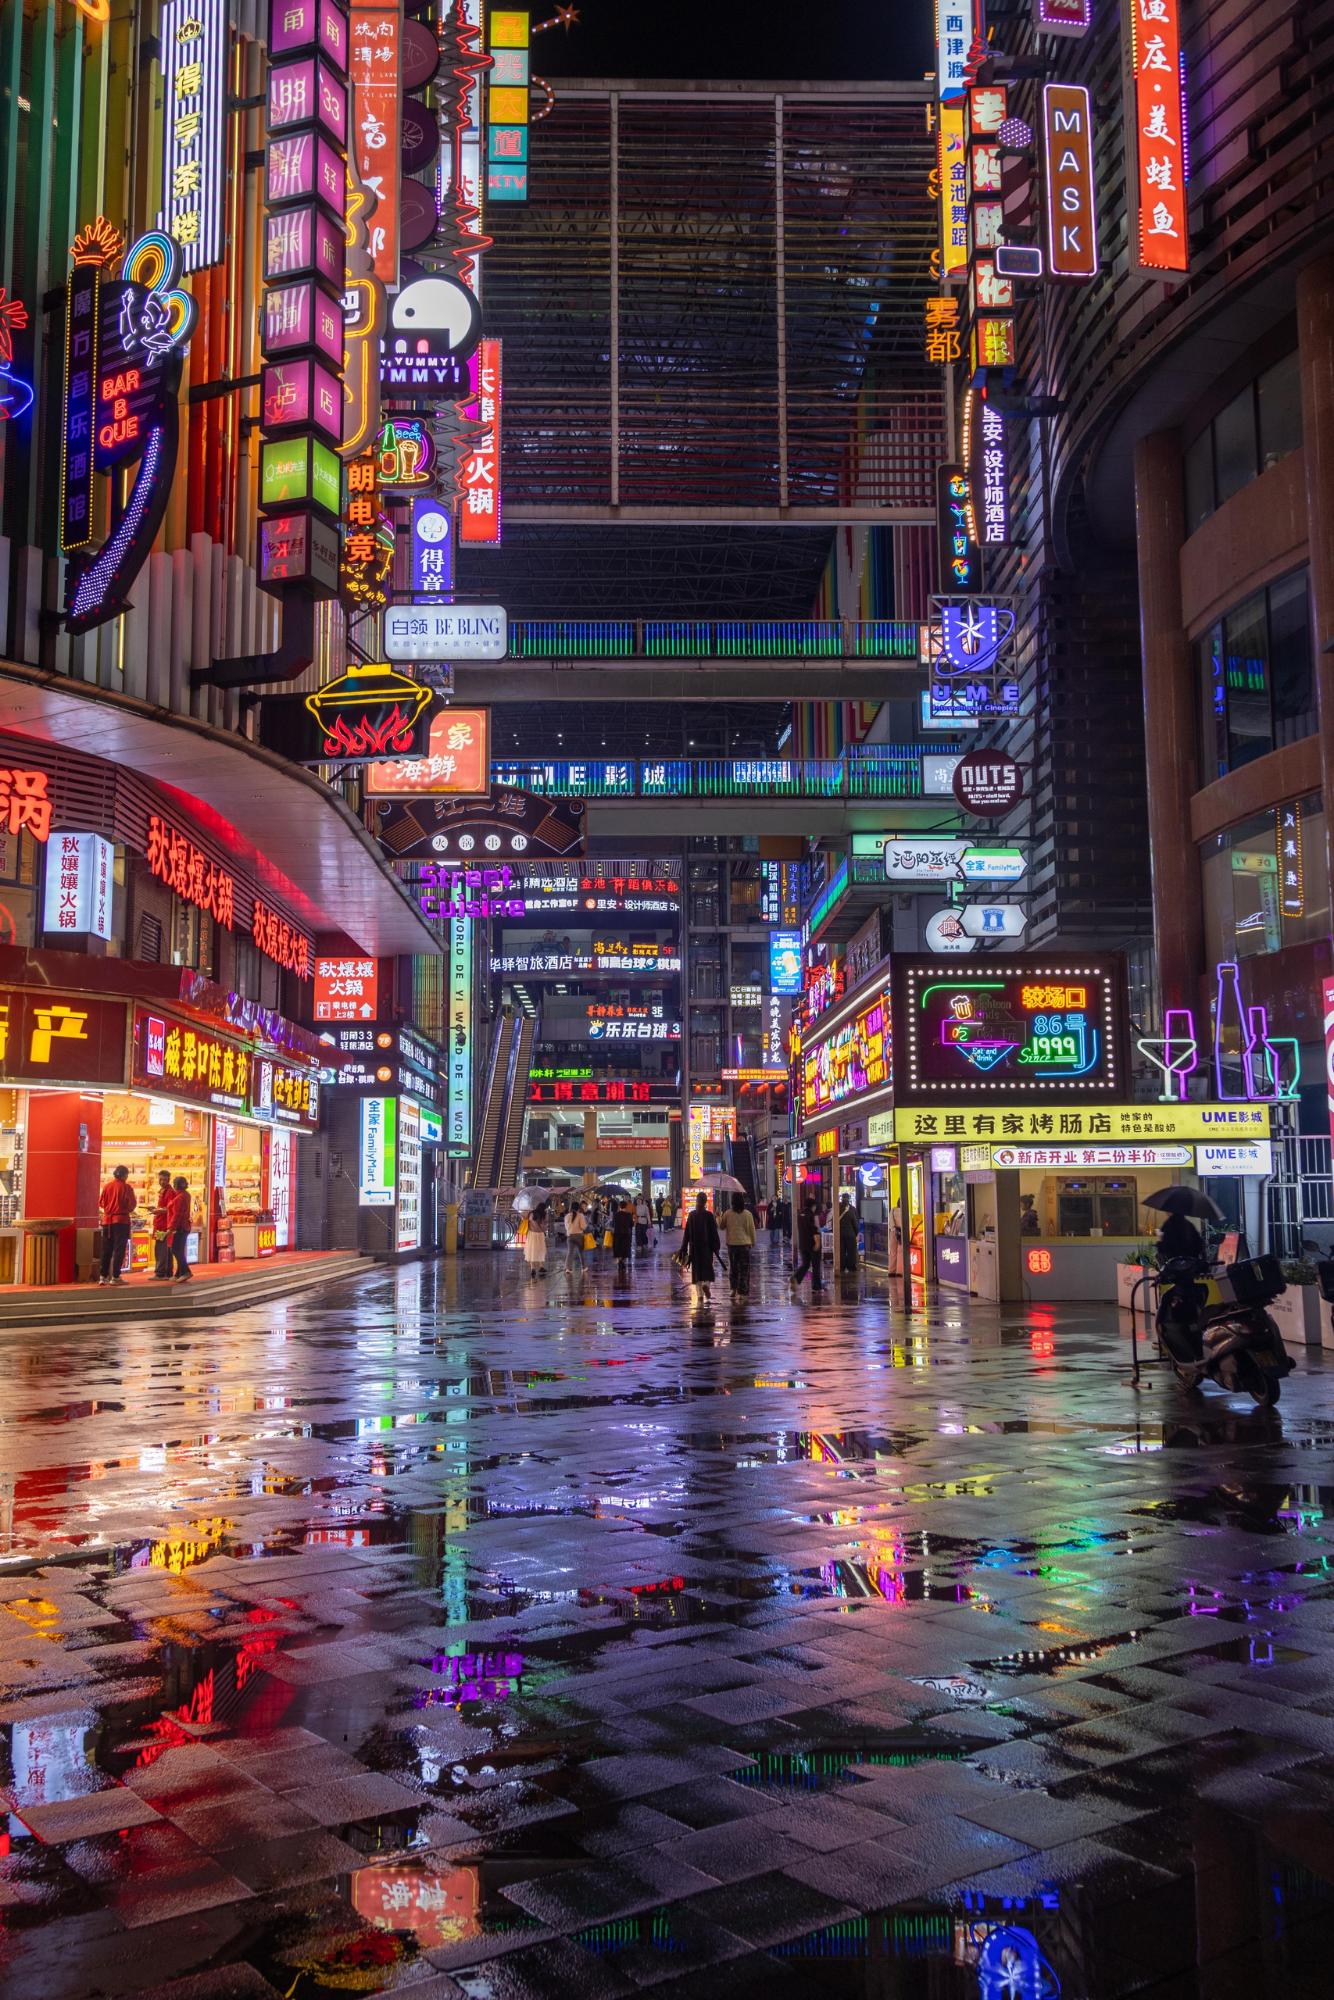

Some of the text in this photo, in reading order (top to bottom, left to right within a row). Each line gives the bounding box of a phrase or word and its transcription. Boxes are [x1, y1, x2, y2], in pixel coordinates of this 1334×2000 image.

[488, 175, 526, 188] KTV
[1054, 110, 1083, 253] MASK
[950, 161, 967, 246] 金池舞蹈
[925, 297, 960, 362] 雾都
[395, 357, 456, 367] YUMMY!
[103, 369, 140, 401] BAR
[69, 289, 91, 522] 魔方音乐酒馆
[114, 399, 127, 420] B
[99, 416, 138, 448] QUE
[347, 445, 375, 562] 朗电竞
[420, 548, 445, 604] 得意
[392, 618, 500, 635] 白领 BE BLING
[932, 685, 1020, 701] UME
[396, 753, 457, 782] 海鲜
[420, 865, 513, 888] Street
[420, 893, 525, 918] Cuisine
[328, 979, 363, 996] 火锅
[1022, 986, 1086, 1008] 较场口
[605, 1022, 668, 1037] 乐乐台球
[1017, 1047, 1052, 1064] Since
[1033, 1036, 1075, 1056] 1999
[164, 1026, 248, 1096] 磁器口陈麻花
[977, 1054, 993, 1062] drink
[915, 1113, 1111, 1135] 这里有家烤肠店
[1120, 1112, 1153, 1122] 她家的
[1120, 1123, 1176, 1132] 特色是酸奶
[365, 1127, 378, 1182] FamilyMart
[1017, 1150, 1077, 1164] 新店开业
[1082, 1149, 1156, 1163] 第二份半价
